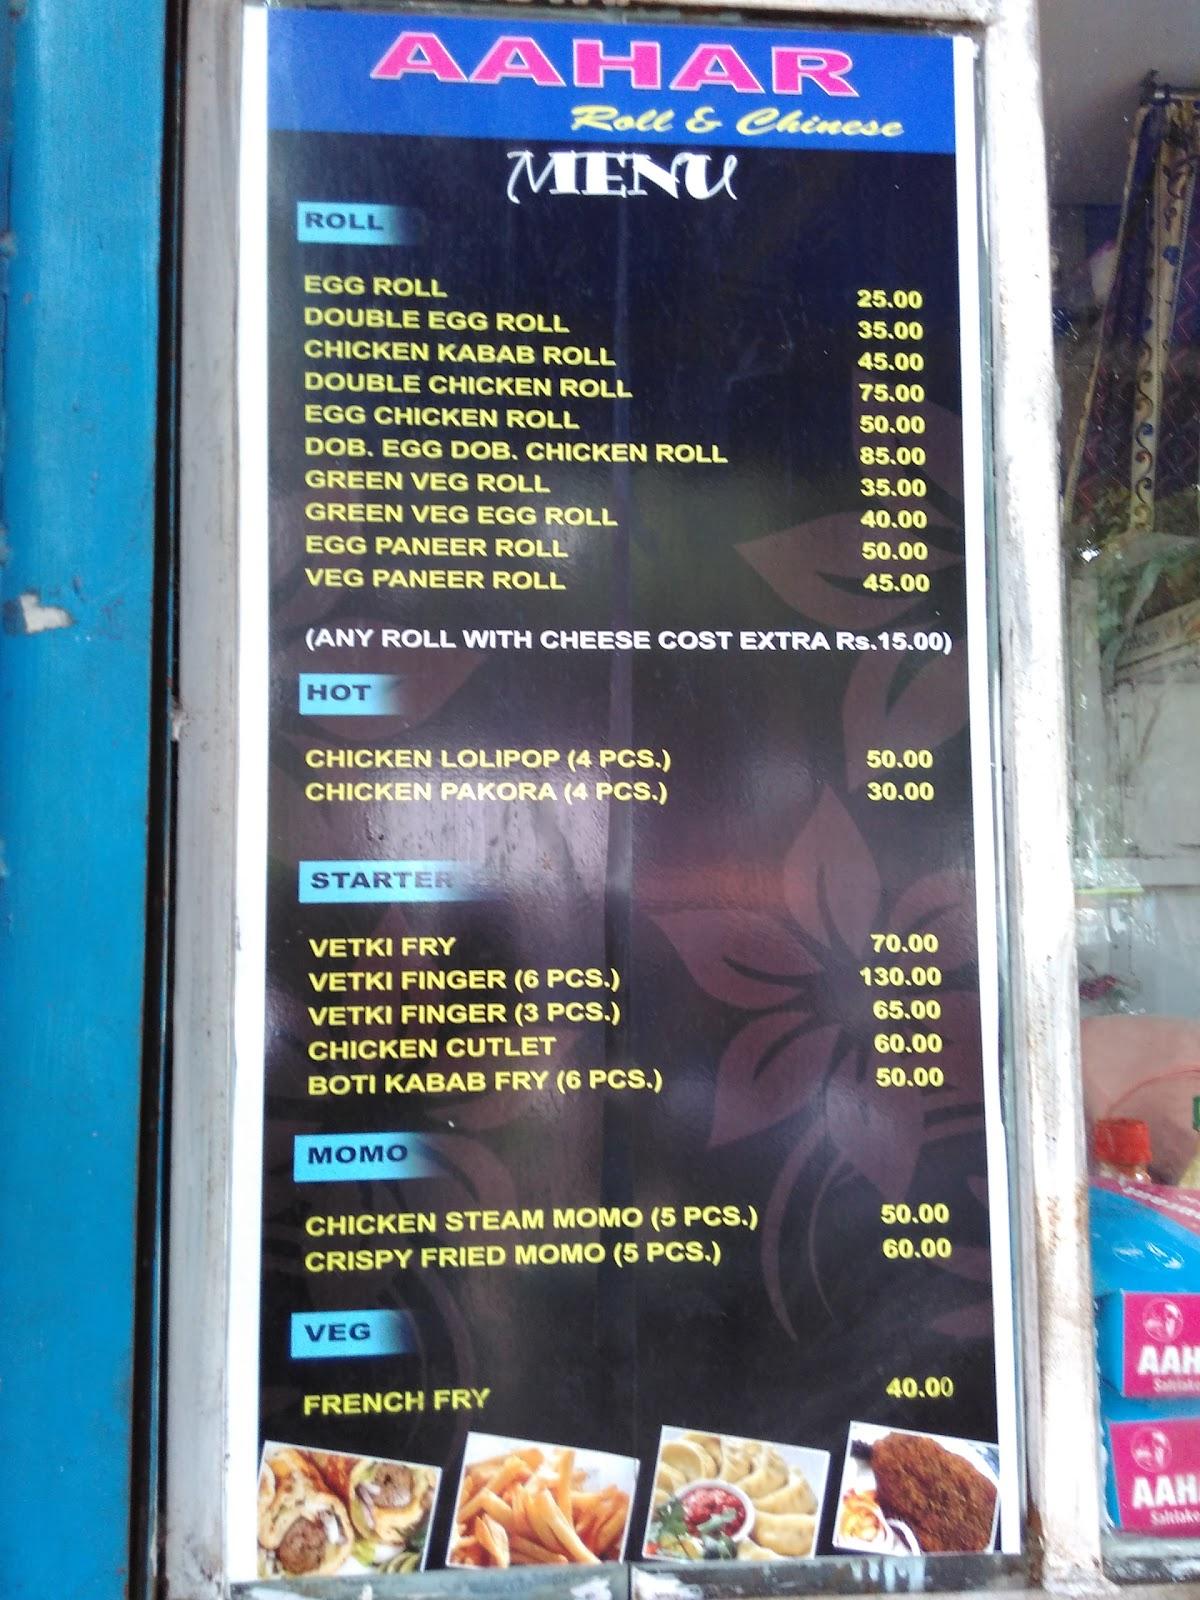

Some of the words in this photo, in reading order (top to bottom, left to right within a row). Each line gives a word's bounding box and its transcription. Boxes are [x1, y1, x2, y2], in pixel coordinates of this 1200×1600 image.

[370, 31, 859, 98] AAHAR
[569, 103, 674, 133] Roll
[685, 106, 722, 132] &
[735, 106, 904, 137] Chinese
[506, 149, 738, 203] MENU
[305, 211, 384, 230] ROLL
[304, 275, 365, 295] EGG
[372, 277, 445, 298] ROLL
[857, 289, 923, 309] 25.00
[304, 307, 420, 329] DOUBLE
[427, 311, 489, 331] EGG
[495, 312, 569, 334] ROLL
[858, 320, 924, 341] 35.00
[304, 339, 430, 361] CHICKEN
[437, 343, 535, 365] KABAB
[543, 345, 615, 367] ROLL
[858, 351, 925, 372] 45.00
[304, 371, 419, 394] DOUBLE
[428, 375, 552, 397] CHICKEN
[559, 378, 632, 399] ROLL
[859, 383, 925, 403] 75.00
[304, 404, 366, 425] EGG
[374, 406, 499, 428] CHICKEN
[506, 409, 579, 430] ROLL
[859, 415, 926, 435] 50.00
[304, 436, 375, 457] DOB.
[382, 439, 443, 459] EGG
[450, 440, 518, 462] DOB.
[525, 442, 648, 463] CHICKEN
[655, 443, 727, 464] ROLL
[859, 446, 927, 466] 85.00
[304, 470, 404, 490] GREEN
[411, 472, 469, 492] VEG
[476, 473, 550, 494] ROLL
[861, 477, 927, 498] 35.00
[304, 502, 404, 523] GREEN
[411, 504, 469, 524] VEG
[477, 505, 537, 526] EGG
[544, 507, 617, 527] ROLL
[860, 509, 928, 529] 40.00
[305, 535, 367, 555] EGG
[375, 536, 487, 557] PANEER
[495, 538, 568, 558] ROLL
[862, 541, 929, 561] 50.00
[306, 568, 364, 587] VEG
[372, 569, 485, 589] PANEER
[492, 571, 566, 590] ROLL
[863, 573, 930, 593] 45.00
[305, 627, 375, 652] (ANY
[381, 628, 457, 649] ROLL
[462, 629, 533, 649] WITH
[539, 629, 651, 650] CHEESE
[657, 630, 734, 651] COST
[739, 631, 831, 651] EXTRA
[836, 631, 953, 656] Rs.15.00)
[307, 684, 371, 701] HOT
[304, 749, 433, 769] CHICKEN
[440, 749, 560, 769] LOLIPOP
[567, 748, 593, 772] (4
[599, 748, 672, 773] PCS.)
[867, 749, 933, 769] 50.00
[304, 782, 433, 802] CHICKEN
[440, 782, 558, 802] PAKORA
[564, 781, 589, 806] (4
[596, 781, 669, 806] PCS.)
[868, 782, 934, 801] 30.00
[311, 872, 453, 888] STARTER
[308, 937, 394, 958] VETKI
[401, 936, 456, 957] FRY
[872, 933, 939, 953] 70.00
[308, 971, 393, 993] VETKI
[401, 969, 506, 991] FINGER
[514, 968, 539, 993] (6
[546, 967, 621, 992] PCS.)
[860, 966, 942, 987] 130.00
[307, 1005, 393, 1026] VETKI
[401, 1003, 507, 1025] FINGER
[514, 1002, 540, 1026] (3
[546, 1001, 621, 1026] PCS.)
[873, 999, 942, 1020] 65.00
[307, 1038, 438, 1061] CHICKEN
[445, 1035, 556, 1058] CUTLET
[874, 1033, 943, 1054] 60.00
[307, 1074, 376, 1096] BOTI
[384, 1071, 487, 1093] KABAB
[494, 1070, 550, 1092] FRY
[556, 1069, 582, 1094] (6
[589, 1068, 663, 1093] PCS.)
[876, 1066, 945, 1088] 50.00
[308, 1145, 408, 1164] MOMO
[305, 1212, 437, 1237] CHICKEN
[445, 1208, 545, 1233] STEAM
[553, 1207, 643, 1228] MOMO
[650, 1206, 677, 1232] (5
[683, 1205, 759, 1230] PCS.)
[880, 1202, 950, 1225] 50.00
[304, 1248, 413, 1273] CRISPY
[420, 1244, 508, 1268] FRIED
[515, 1243, 605, 1264] MOMO
[613, 1242, 639, 1267] (5
[646, 1240, 722, 1266] PCS.)
[882, 1237, 953, 1259] 60.00
[303, 1322, 371, 1343] VEG
[885, 1376, 954, 1399] 40.00
[303, 1391, 425, 1416] FRENCH
[433, 1387, 491, 1410] FRY
[1132, 1474, 1200, 1509] AAH
